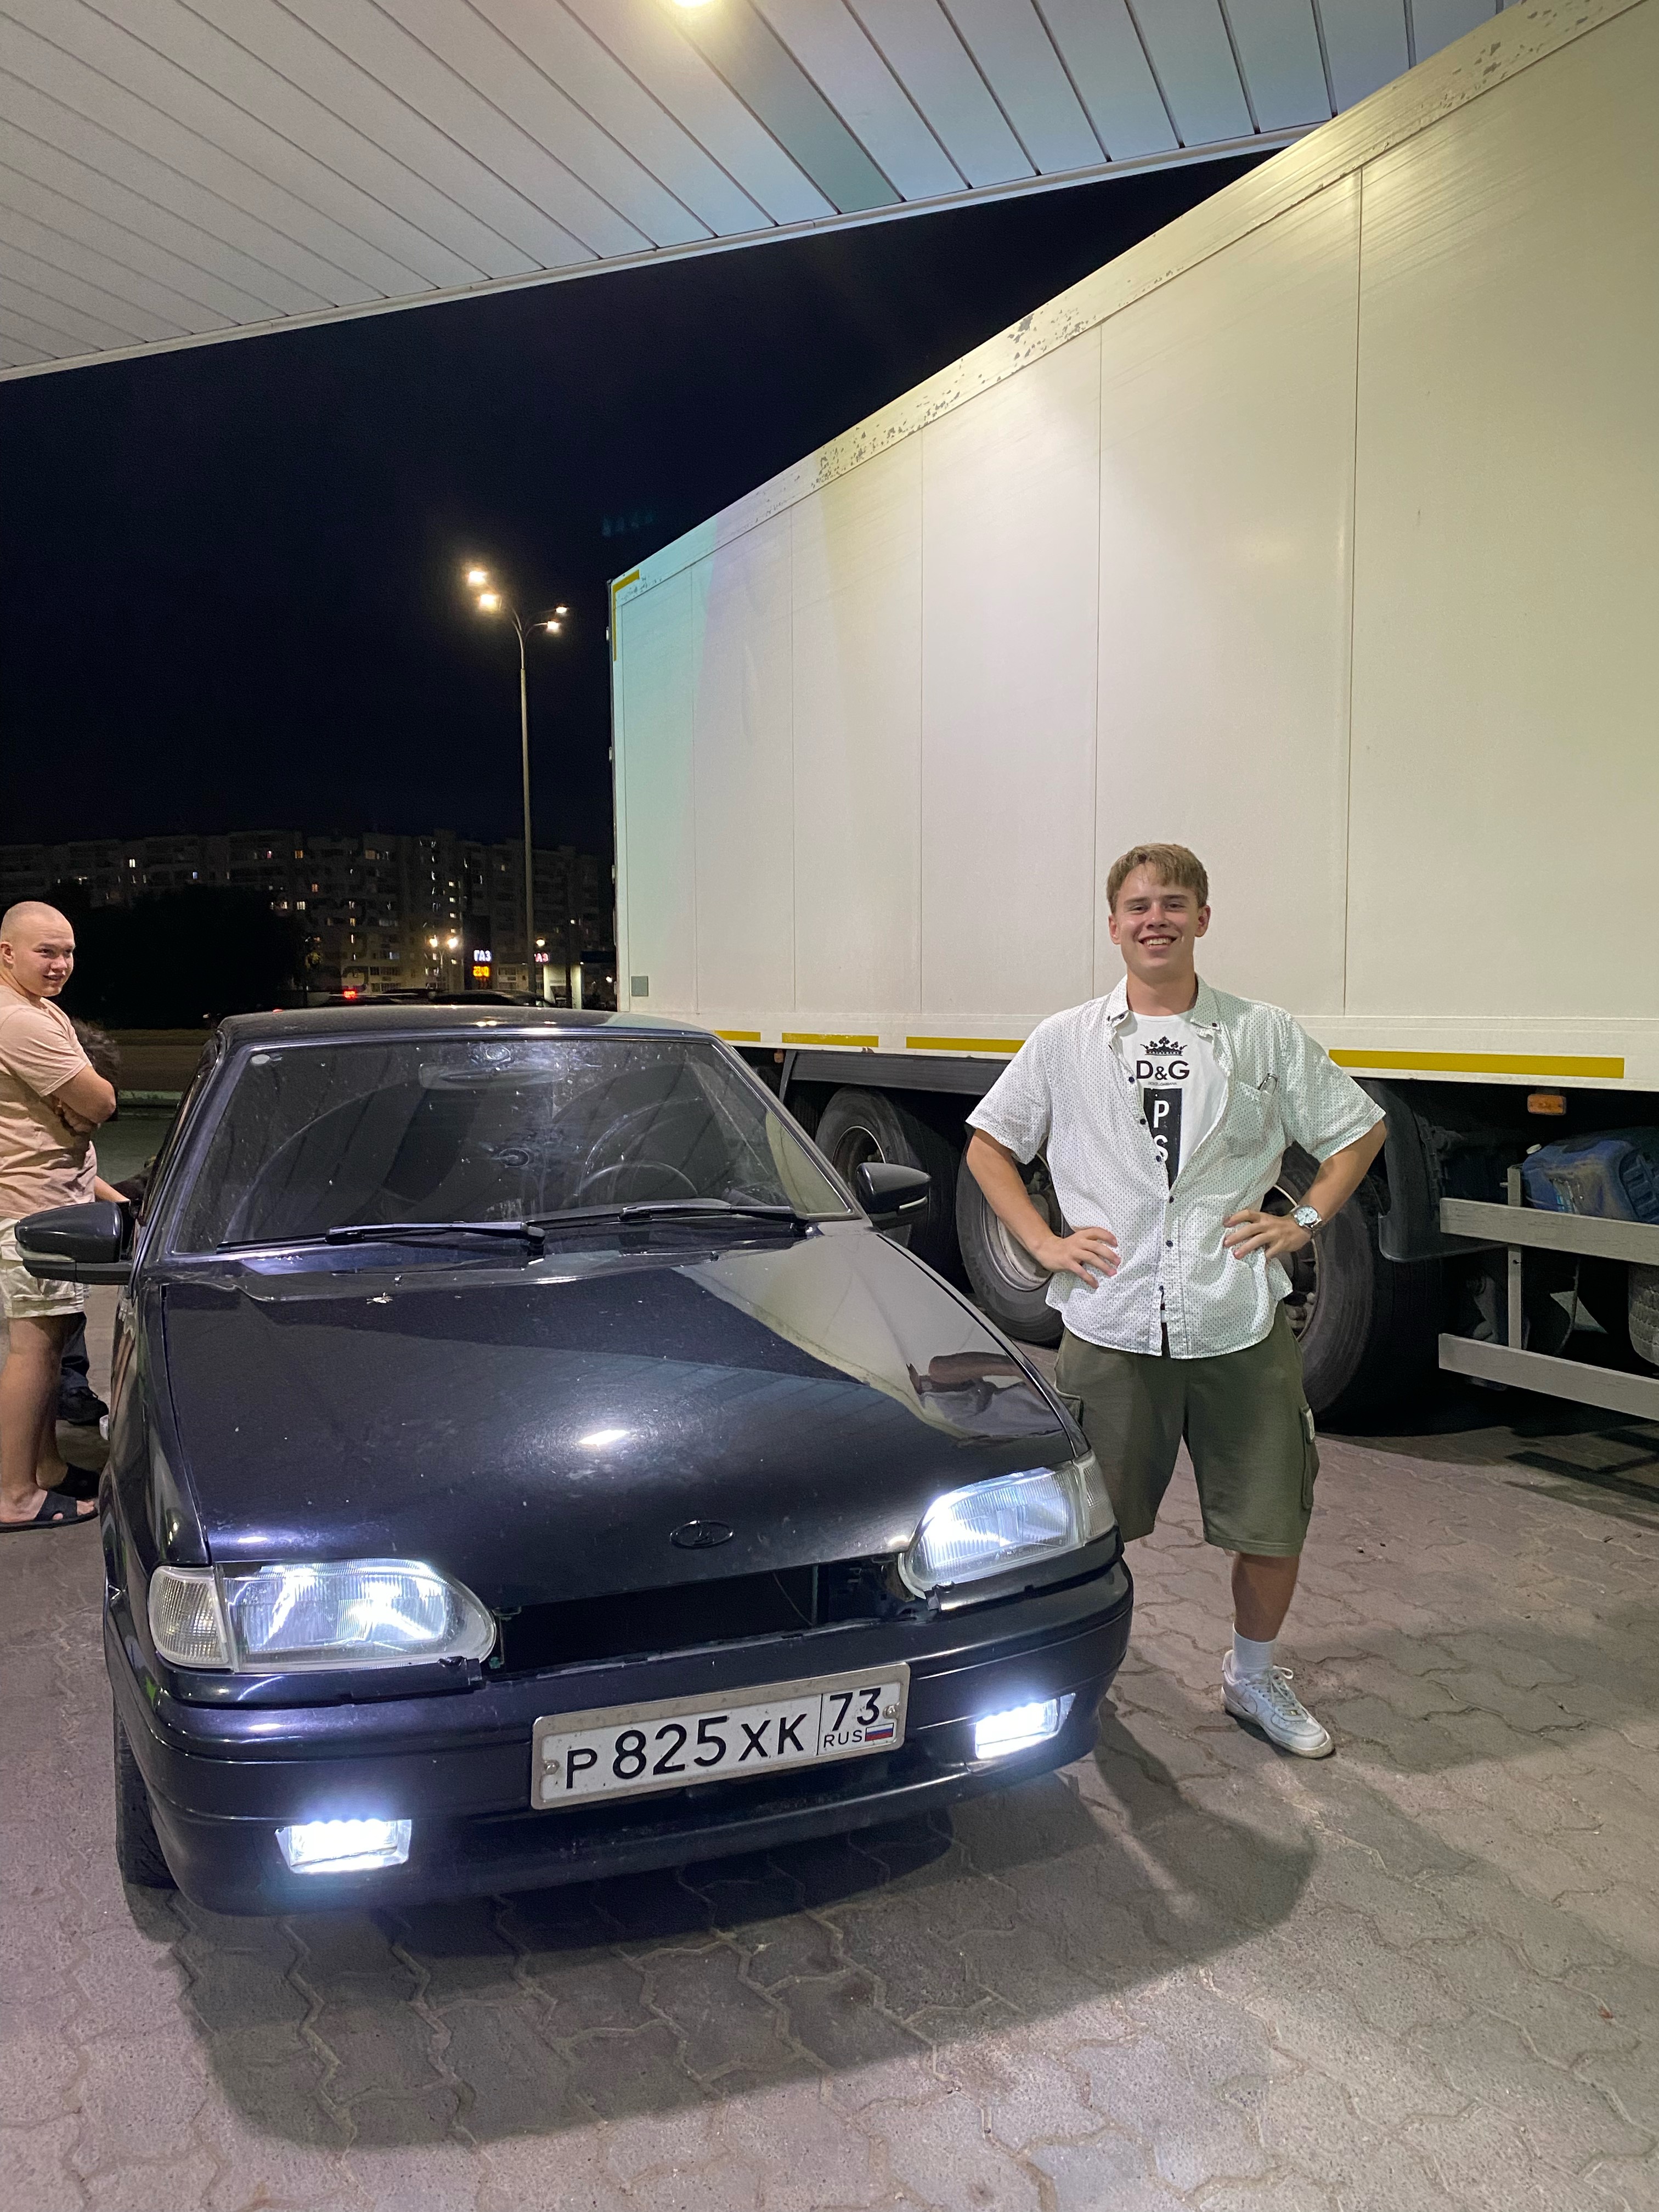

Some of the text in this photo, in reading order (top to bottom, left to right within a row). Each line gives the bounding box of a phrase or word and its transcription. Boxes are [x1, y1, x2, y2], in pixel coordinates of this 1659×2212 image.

[474, 950, 491, 962] ГАЗ
[534, 953, 549, 962] АЗ
[1136, 1060, 1189, 1080] D&G
[828, 1688, 882, 1732] 73
[823, 1729, 862, 1748] RUS
